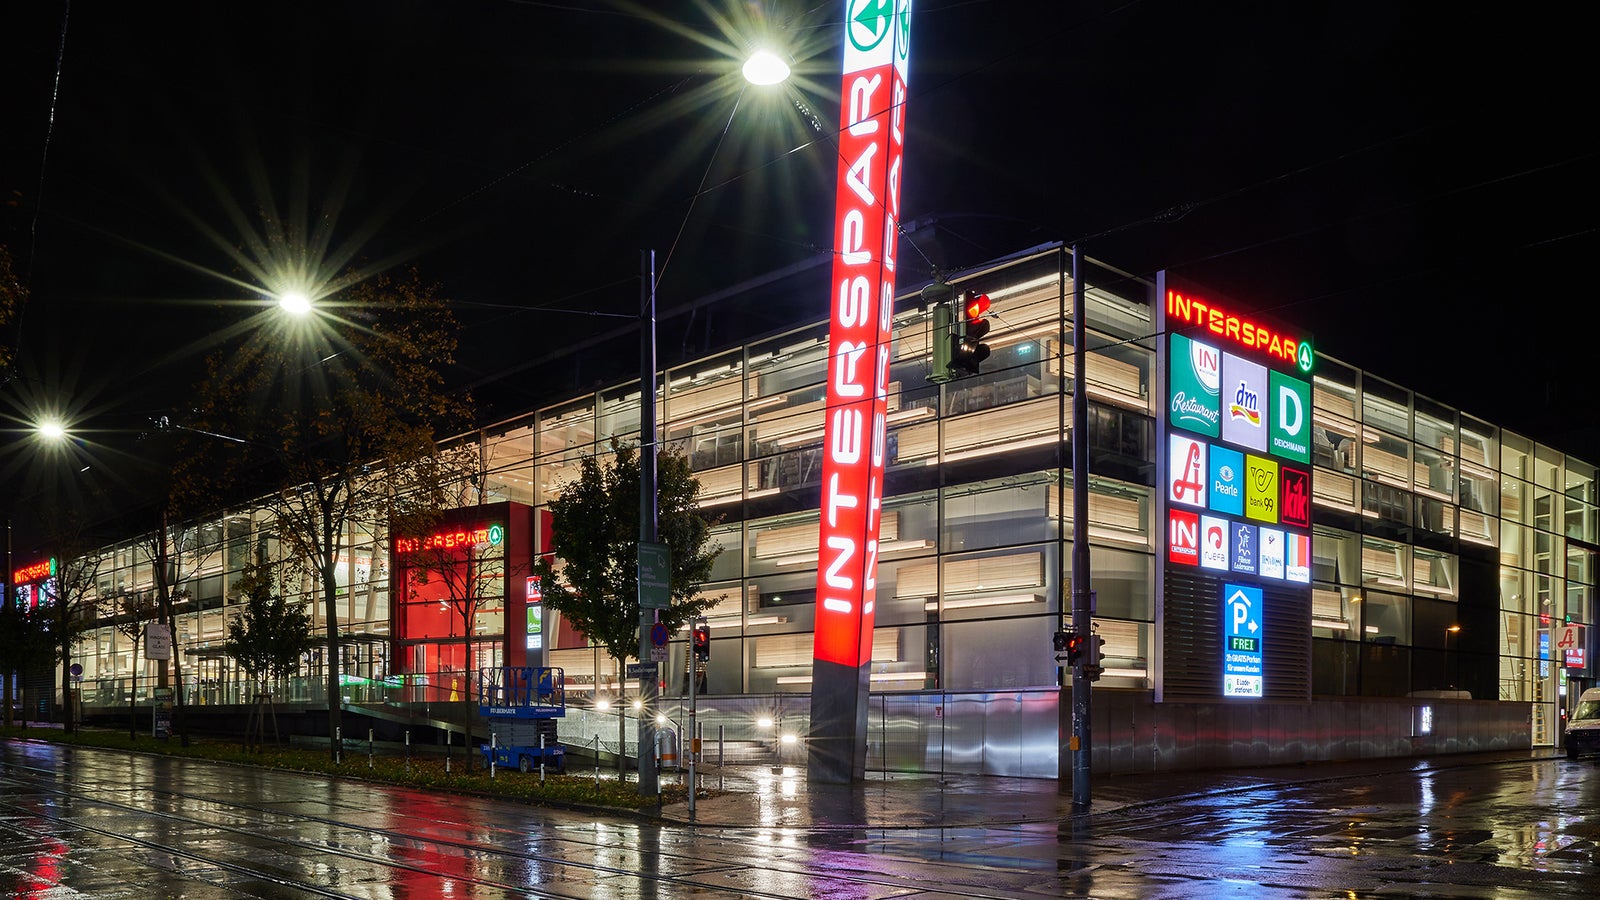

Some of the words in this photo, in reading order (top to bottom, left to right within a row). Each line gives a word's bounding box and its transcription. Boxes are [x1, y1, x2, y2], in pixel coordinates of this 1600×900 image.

[1168, 291, 1297, 363] INTERSPAR
[823, 73, 882, 613] INTERSPAR
[863, 79, 904, 615] INTERSPAR
[1199, 348, 1217, 371] IN
[1172, 391, 1219, 423] Restaurant
[1236, 383, 1257, 410] dm
[1279, 386, 1303, 436] D
[1274, 437, 1306, 454] DEICHMANN
[1215, 480, 1238, 497] Pearle
[1250, 497, 1263, 507] bank
[1264, 497, 1274, 512] 99
[1171, 518, 1197, 549] IN
[1233, 602, 1248, 634] P
[1233, 637, 1254, 650] FREI
